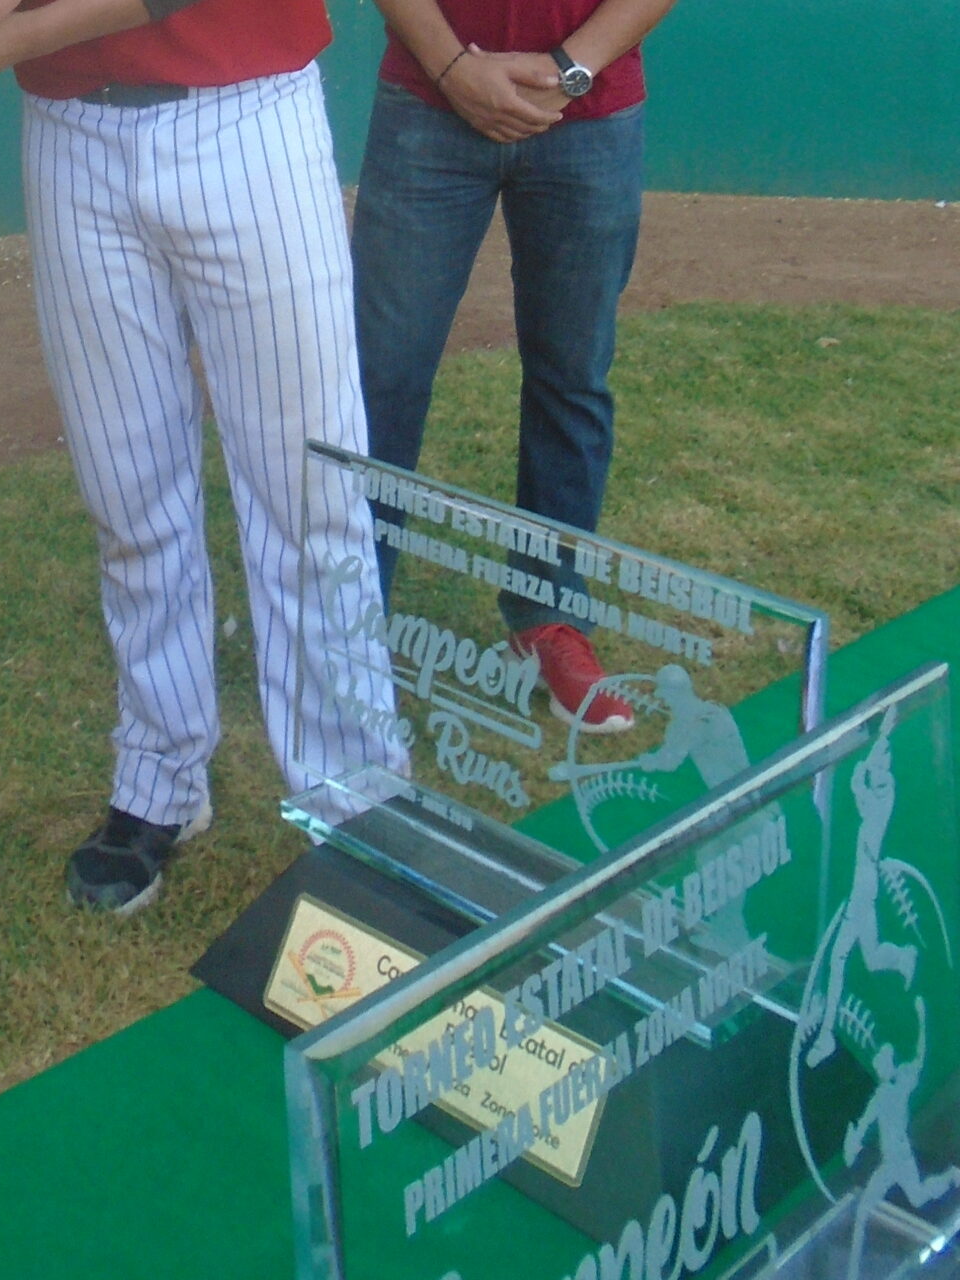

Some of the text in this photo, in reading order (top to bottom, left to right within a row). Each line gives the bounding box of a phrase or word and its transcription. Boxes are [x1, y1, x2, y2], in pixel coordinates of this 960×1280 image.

[323, 550, 540, 717] Campeón
[350, 462, 755, 635] TORNEO ESTATAL DE BEISBOL
[374, 518, 713, 666] PRIMERA FUERZA ZONA NORTE
[428, 710, 532, 808] Runs
[351, 1006, 496, 1150] TORNEO
[503, 923, 631, 1049] ESTATAL
[642, 885, 679, 958] DE
[683, 814, 791, 929] BEISBOL
[404, 1102, 535, 1237] PRIMERA
[540, 1032, 632, 1137] FUERZA
[635, 985, 695, 1068] ZONA
